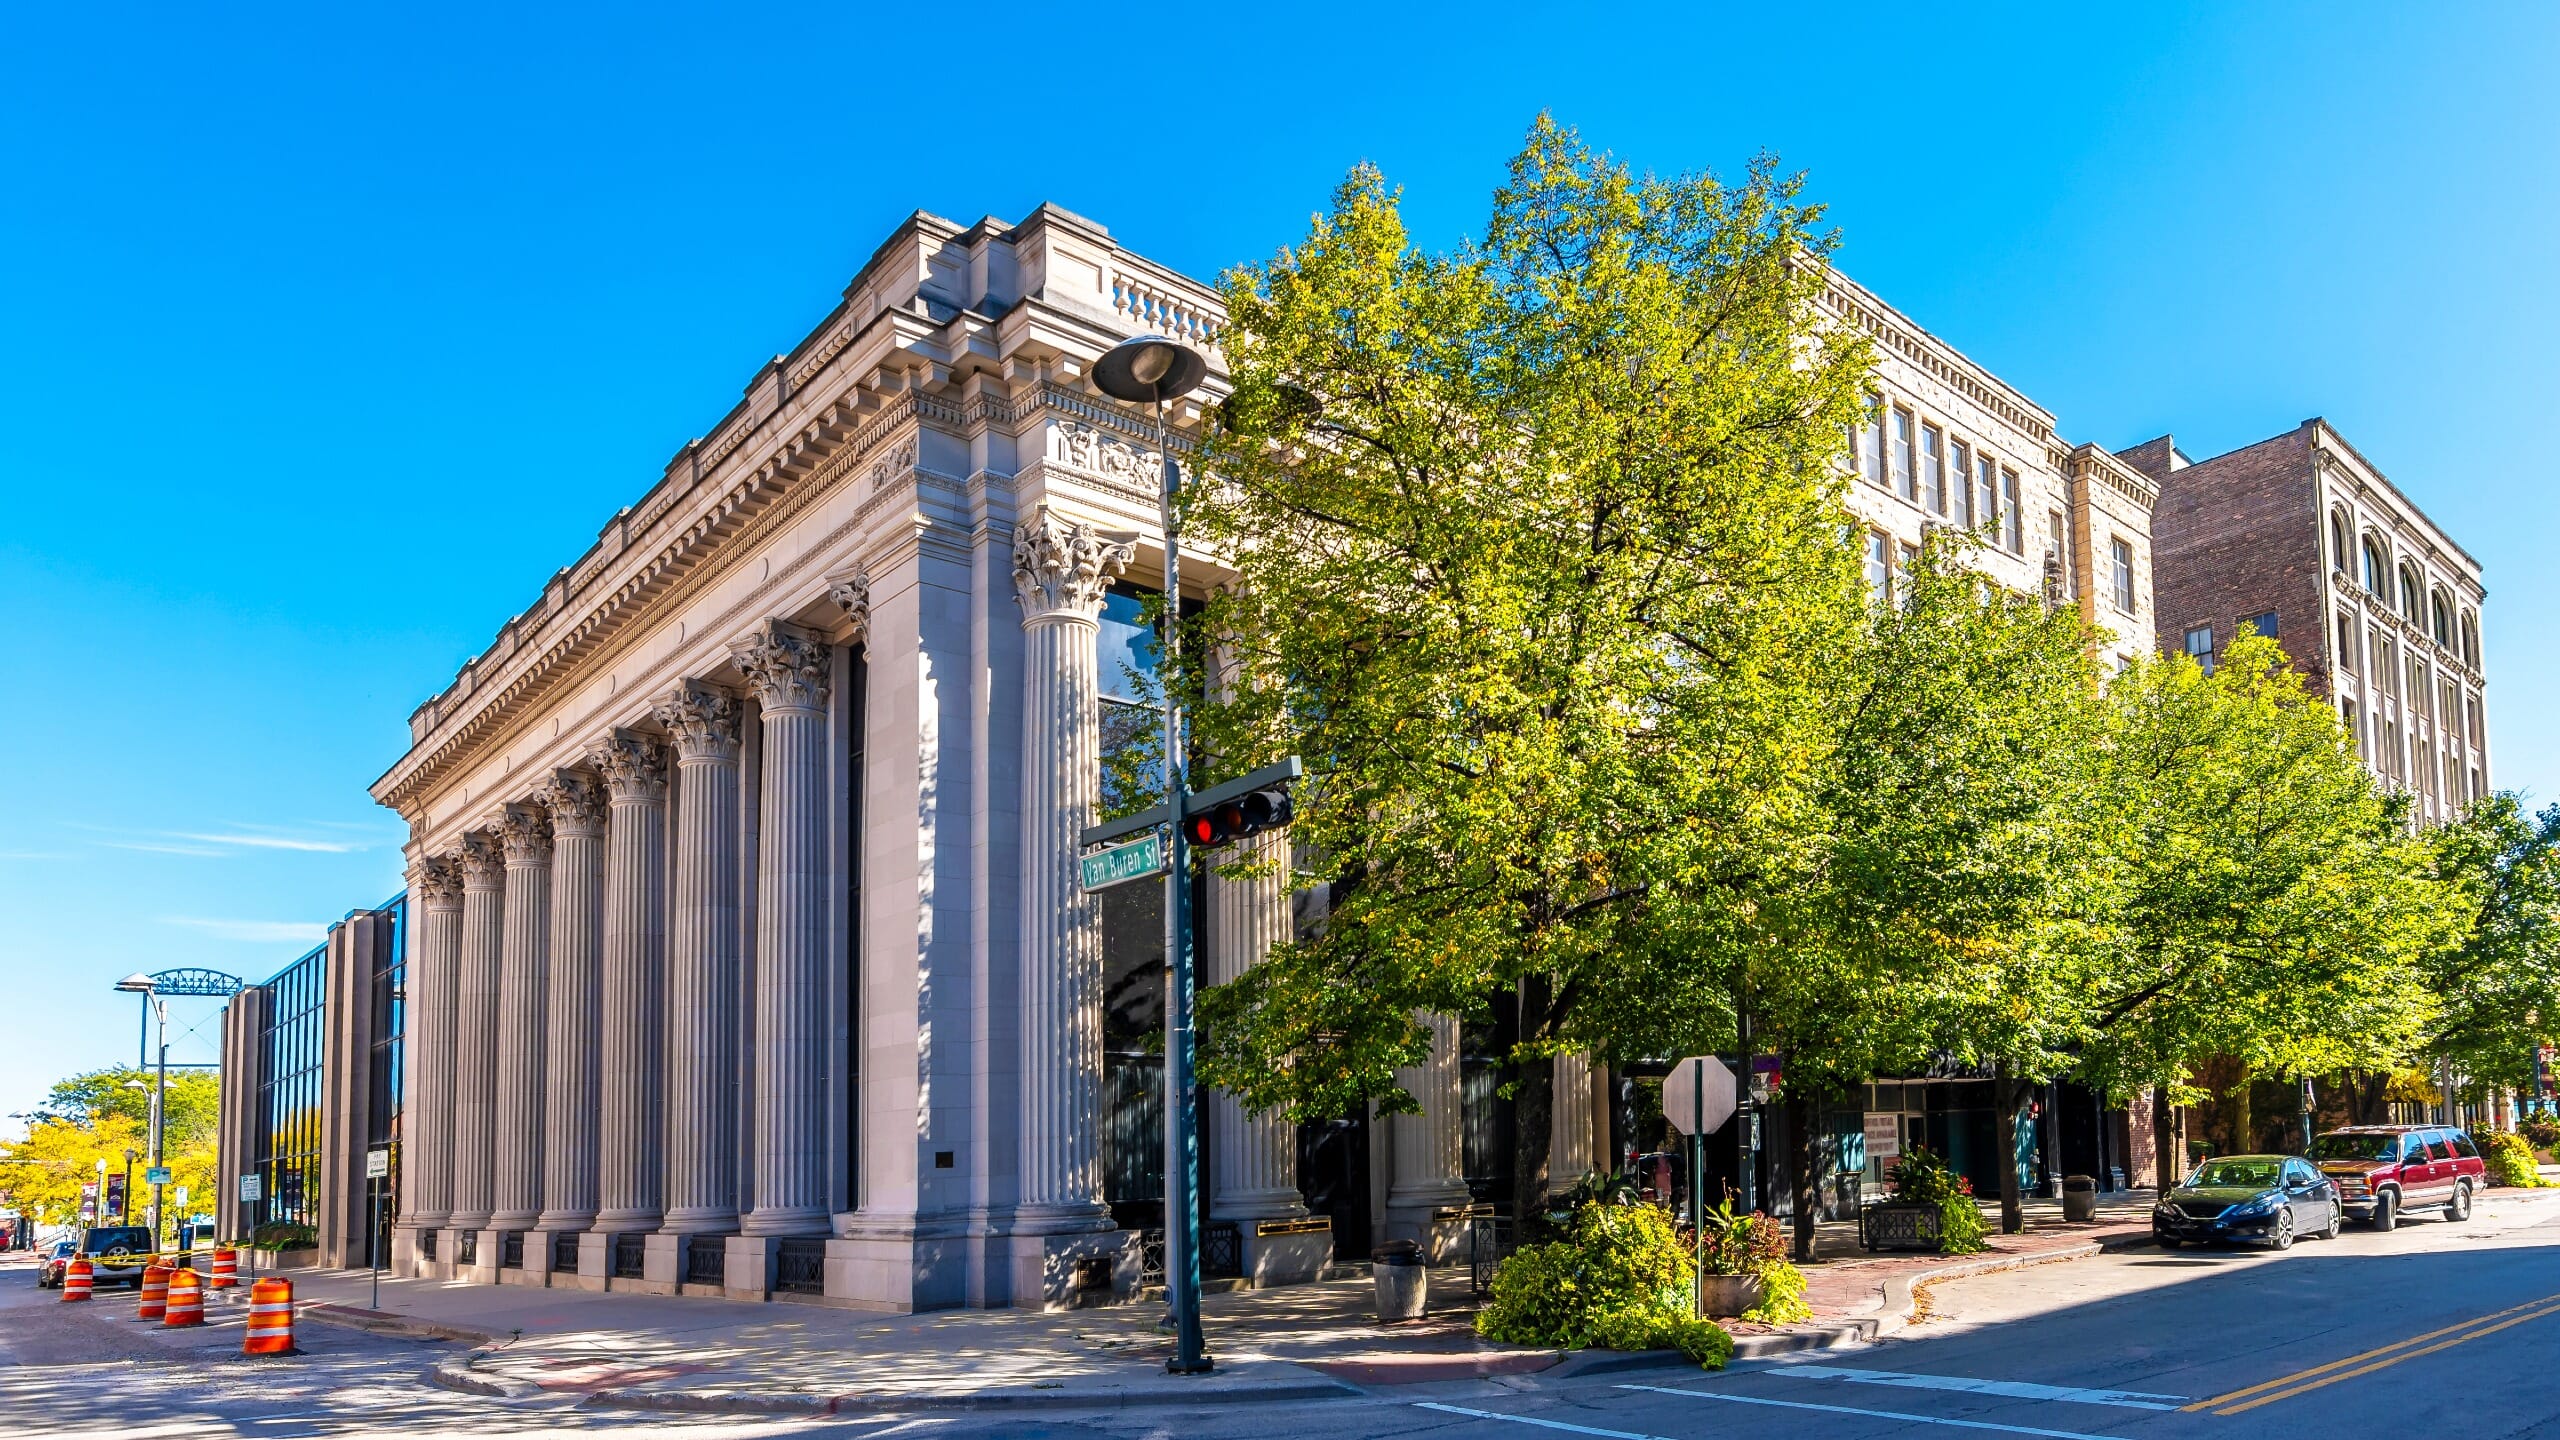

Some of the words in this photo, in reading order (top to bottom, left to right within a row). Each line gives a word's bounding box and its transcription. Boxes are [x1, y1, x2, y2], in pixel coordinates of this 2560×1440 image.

[1086, 861, 1105, 883] Van
[1109, 851, 1140, 878] Buren
[1145, 842, 1157, 867] St
